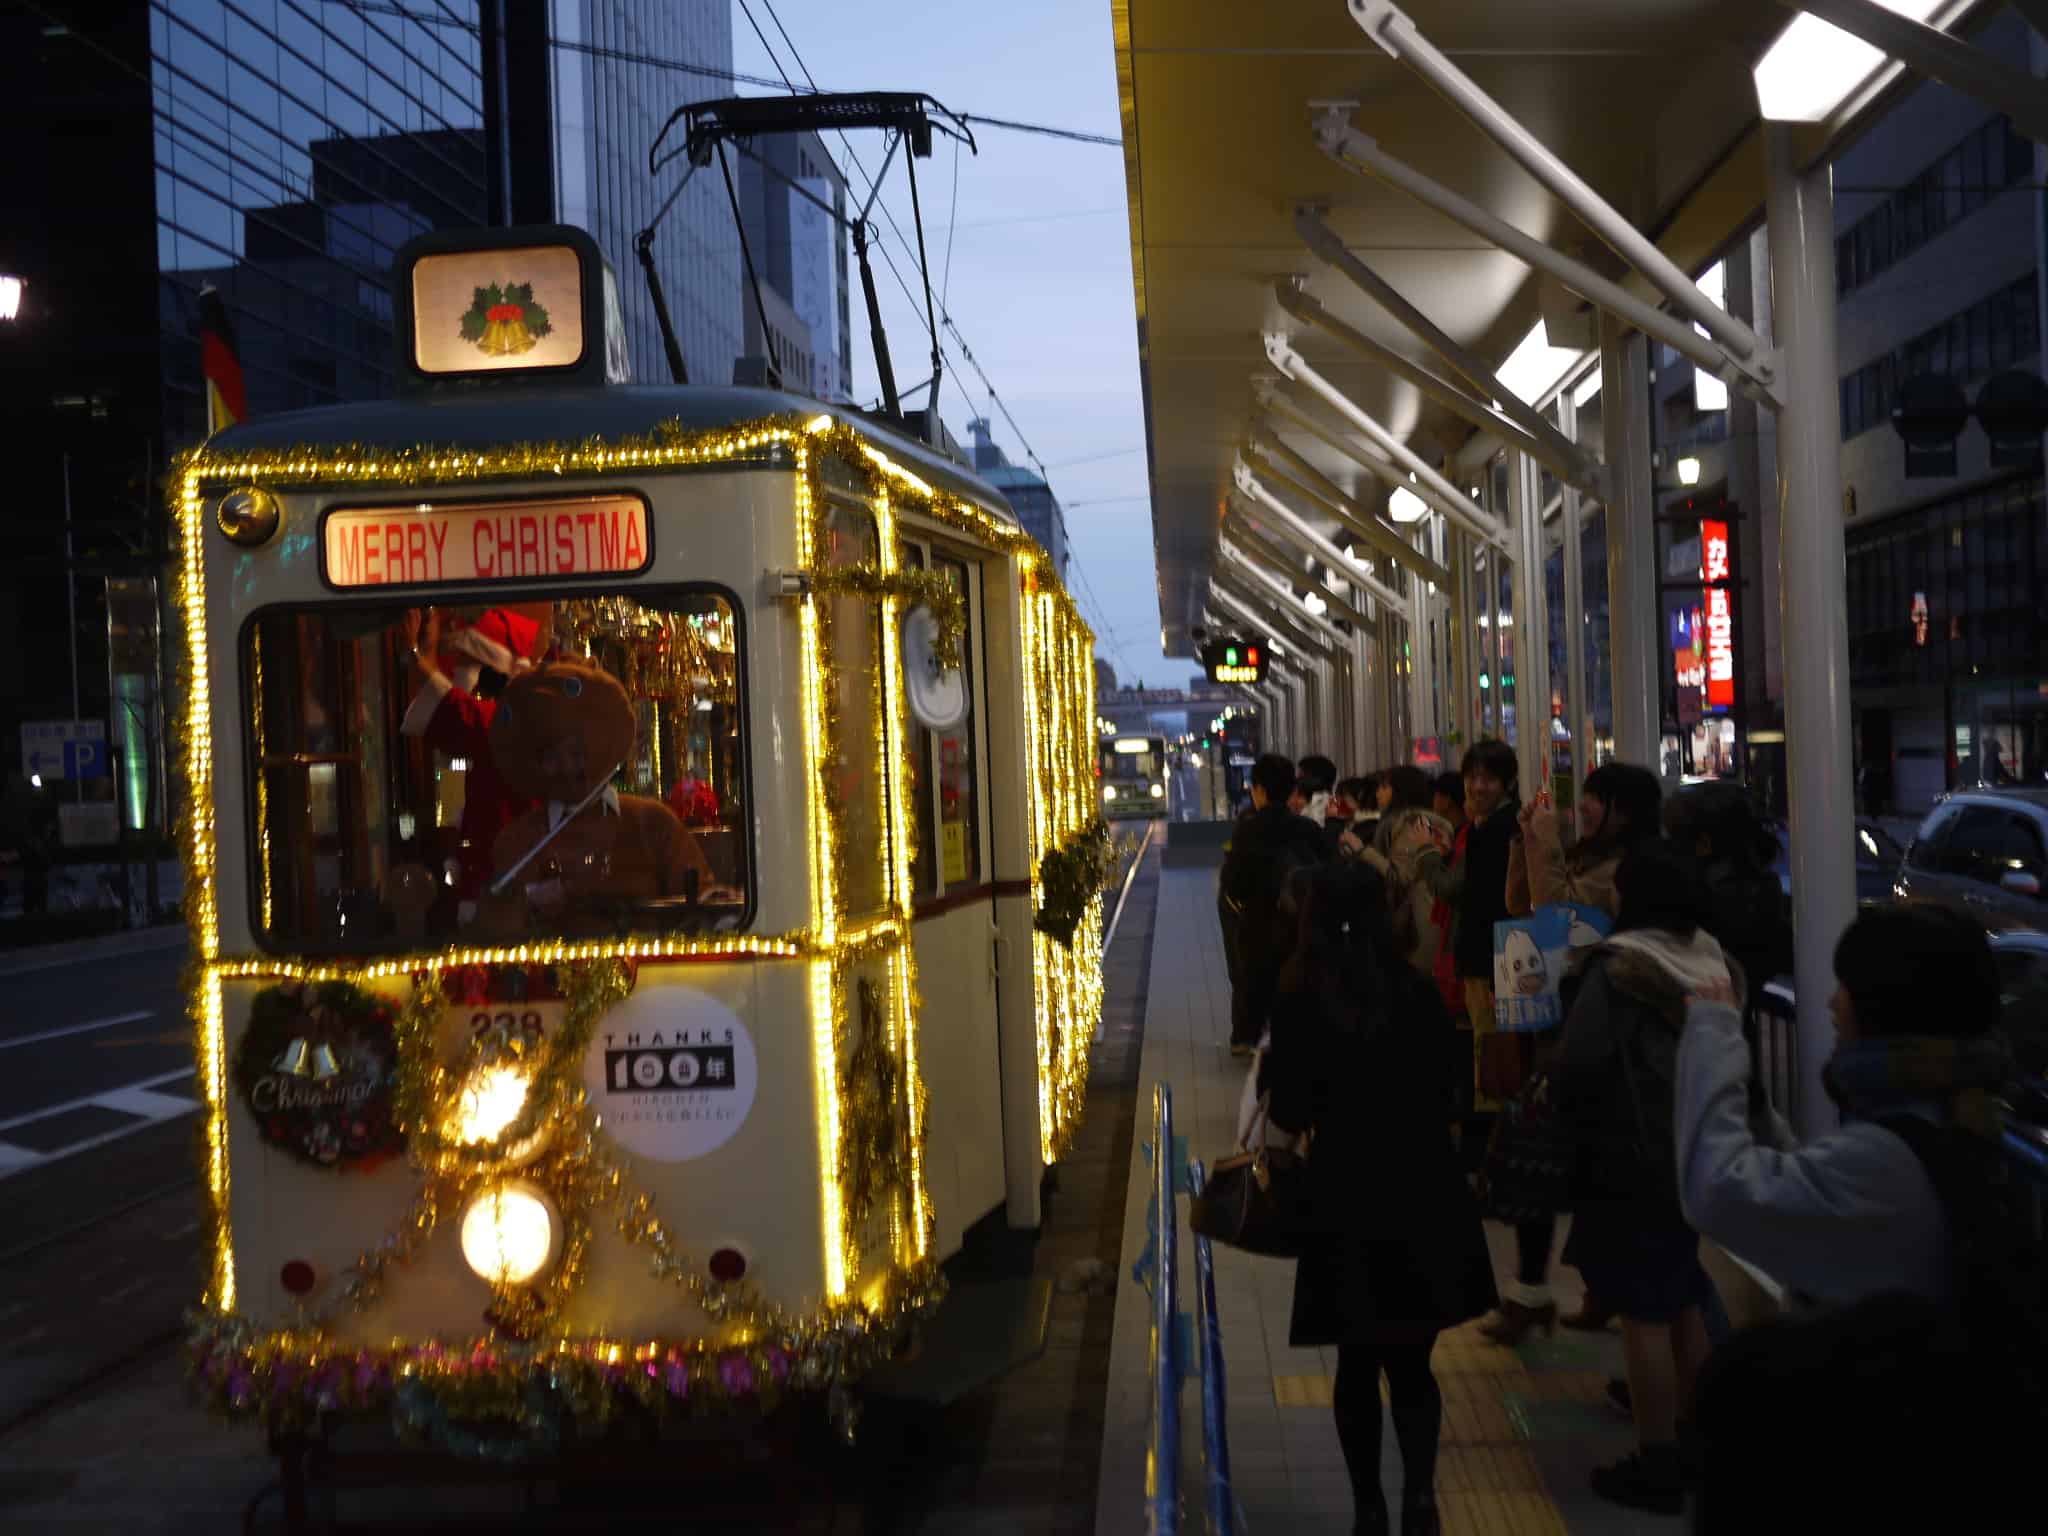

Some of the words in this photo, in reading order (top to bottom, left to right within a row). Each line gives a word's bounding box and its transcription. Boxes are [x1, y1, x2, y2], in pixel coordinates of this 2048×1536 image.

[338, 518, 449, 584] MERRY
[472, 509, 643, 578] CHRISTMA
[604, 1027, 734, 1048] THANKS
